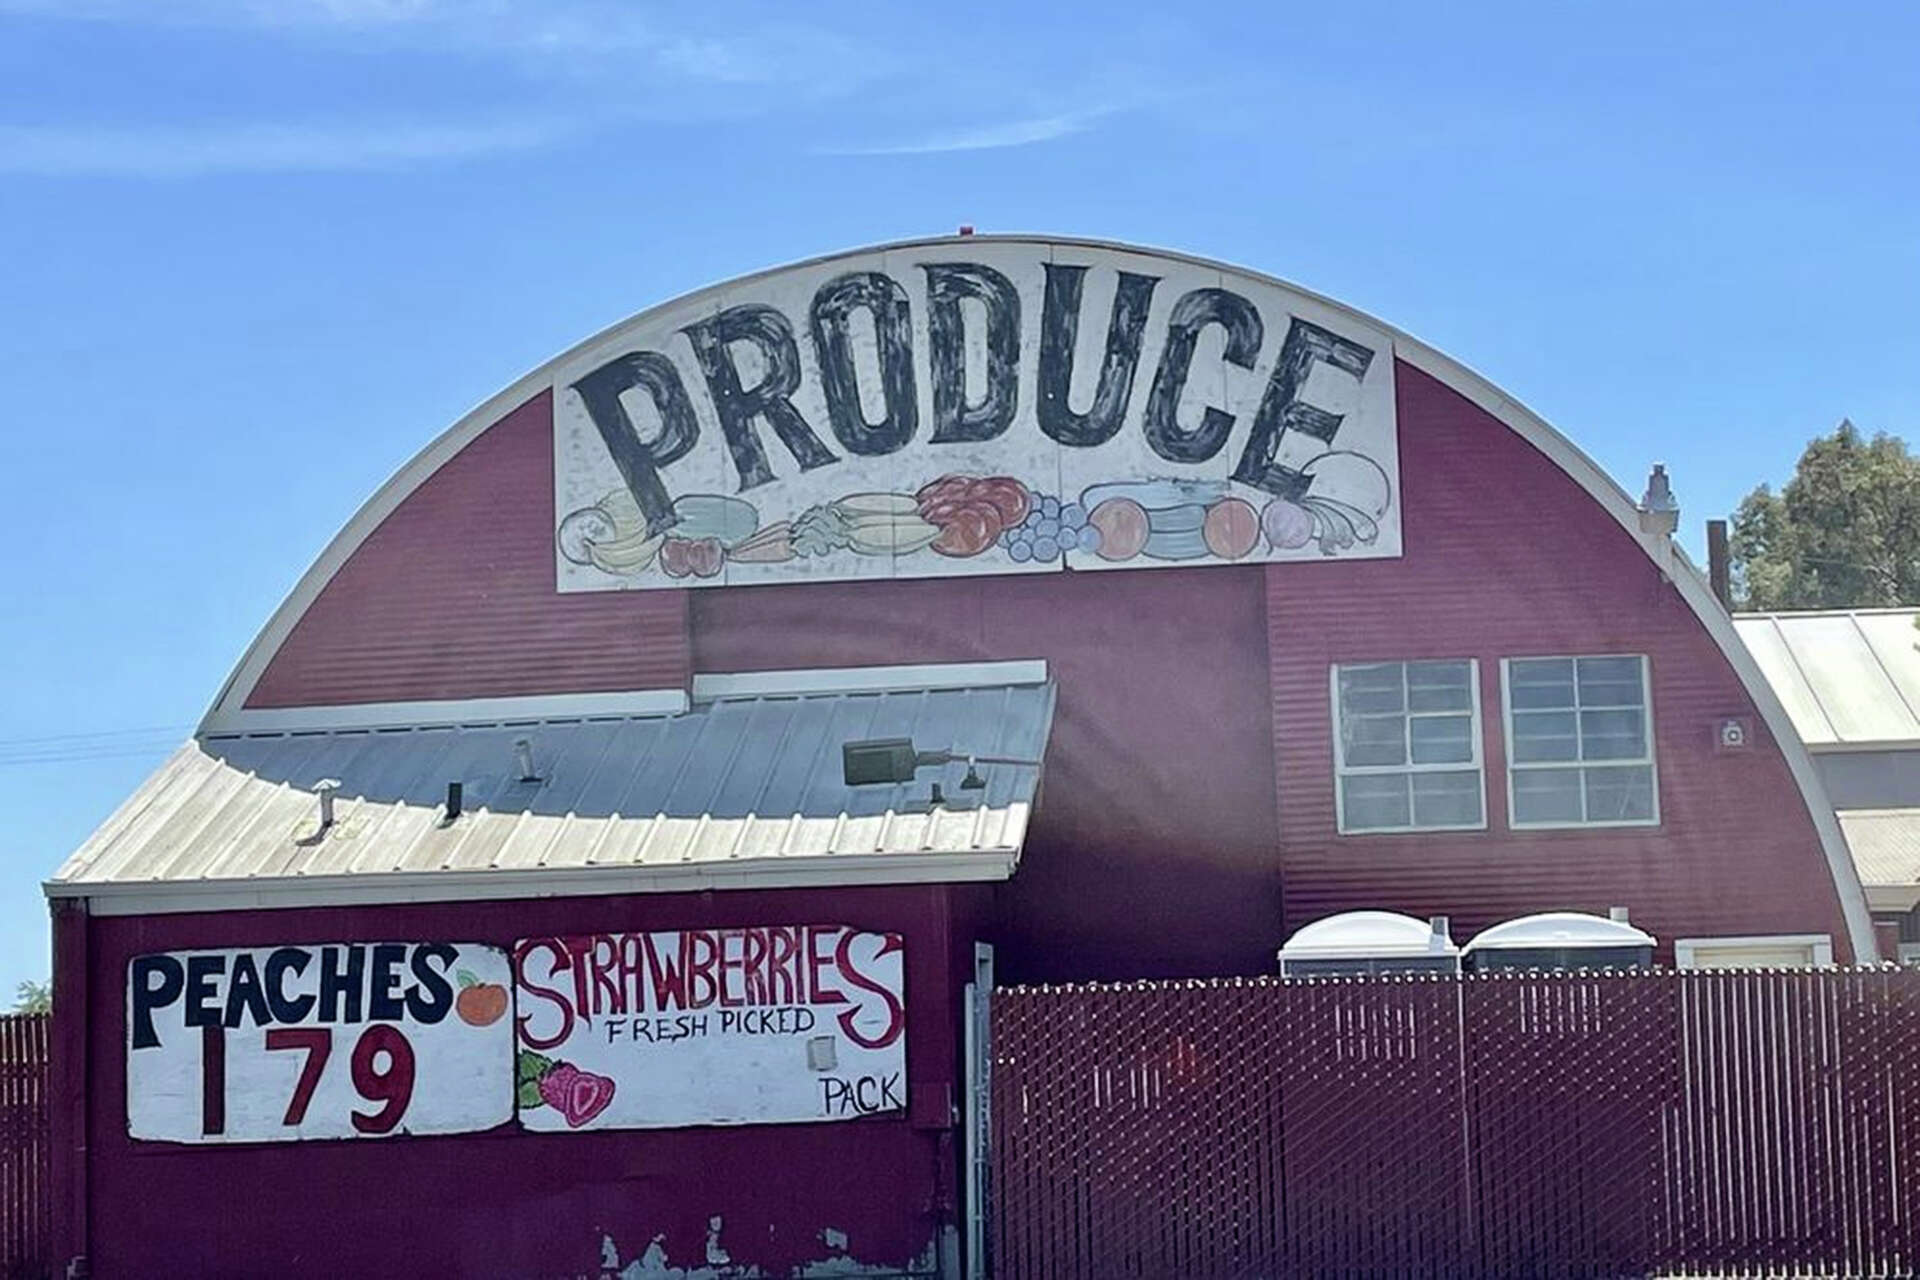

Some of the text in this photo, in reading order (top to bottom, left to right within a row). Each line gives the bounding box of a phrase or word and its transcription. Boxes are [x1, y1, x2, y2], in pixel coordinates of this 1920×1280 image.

[569, 261, 1375, 535] PRODUCE
[132, 943, 460, 1049] PEACHES
[515, 925, 905, 1050] STRAWBERRIES
[606, 1007, 816, 1044] FRESH PICKED
[819, 1072, 902, 1115] PACK
